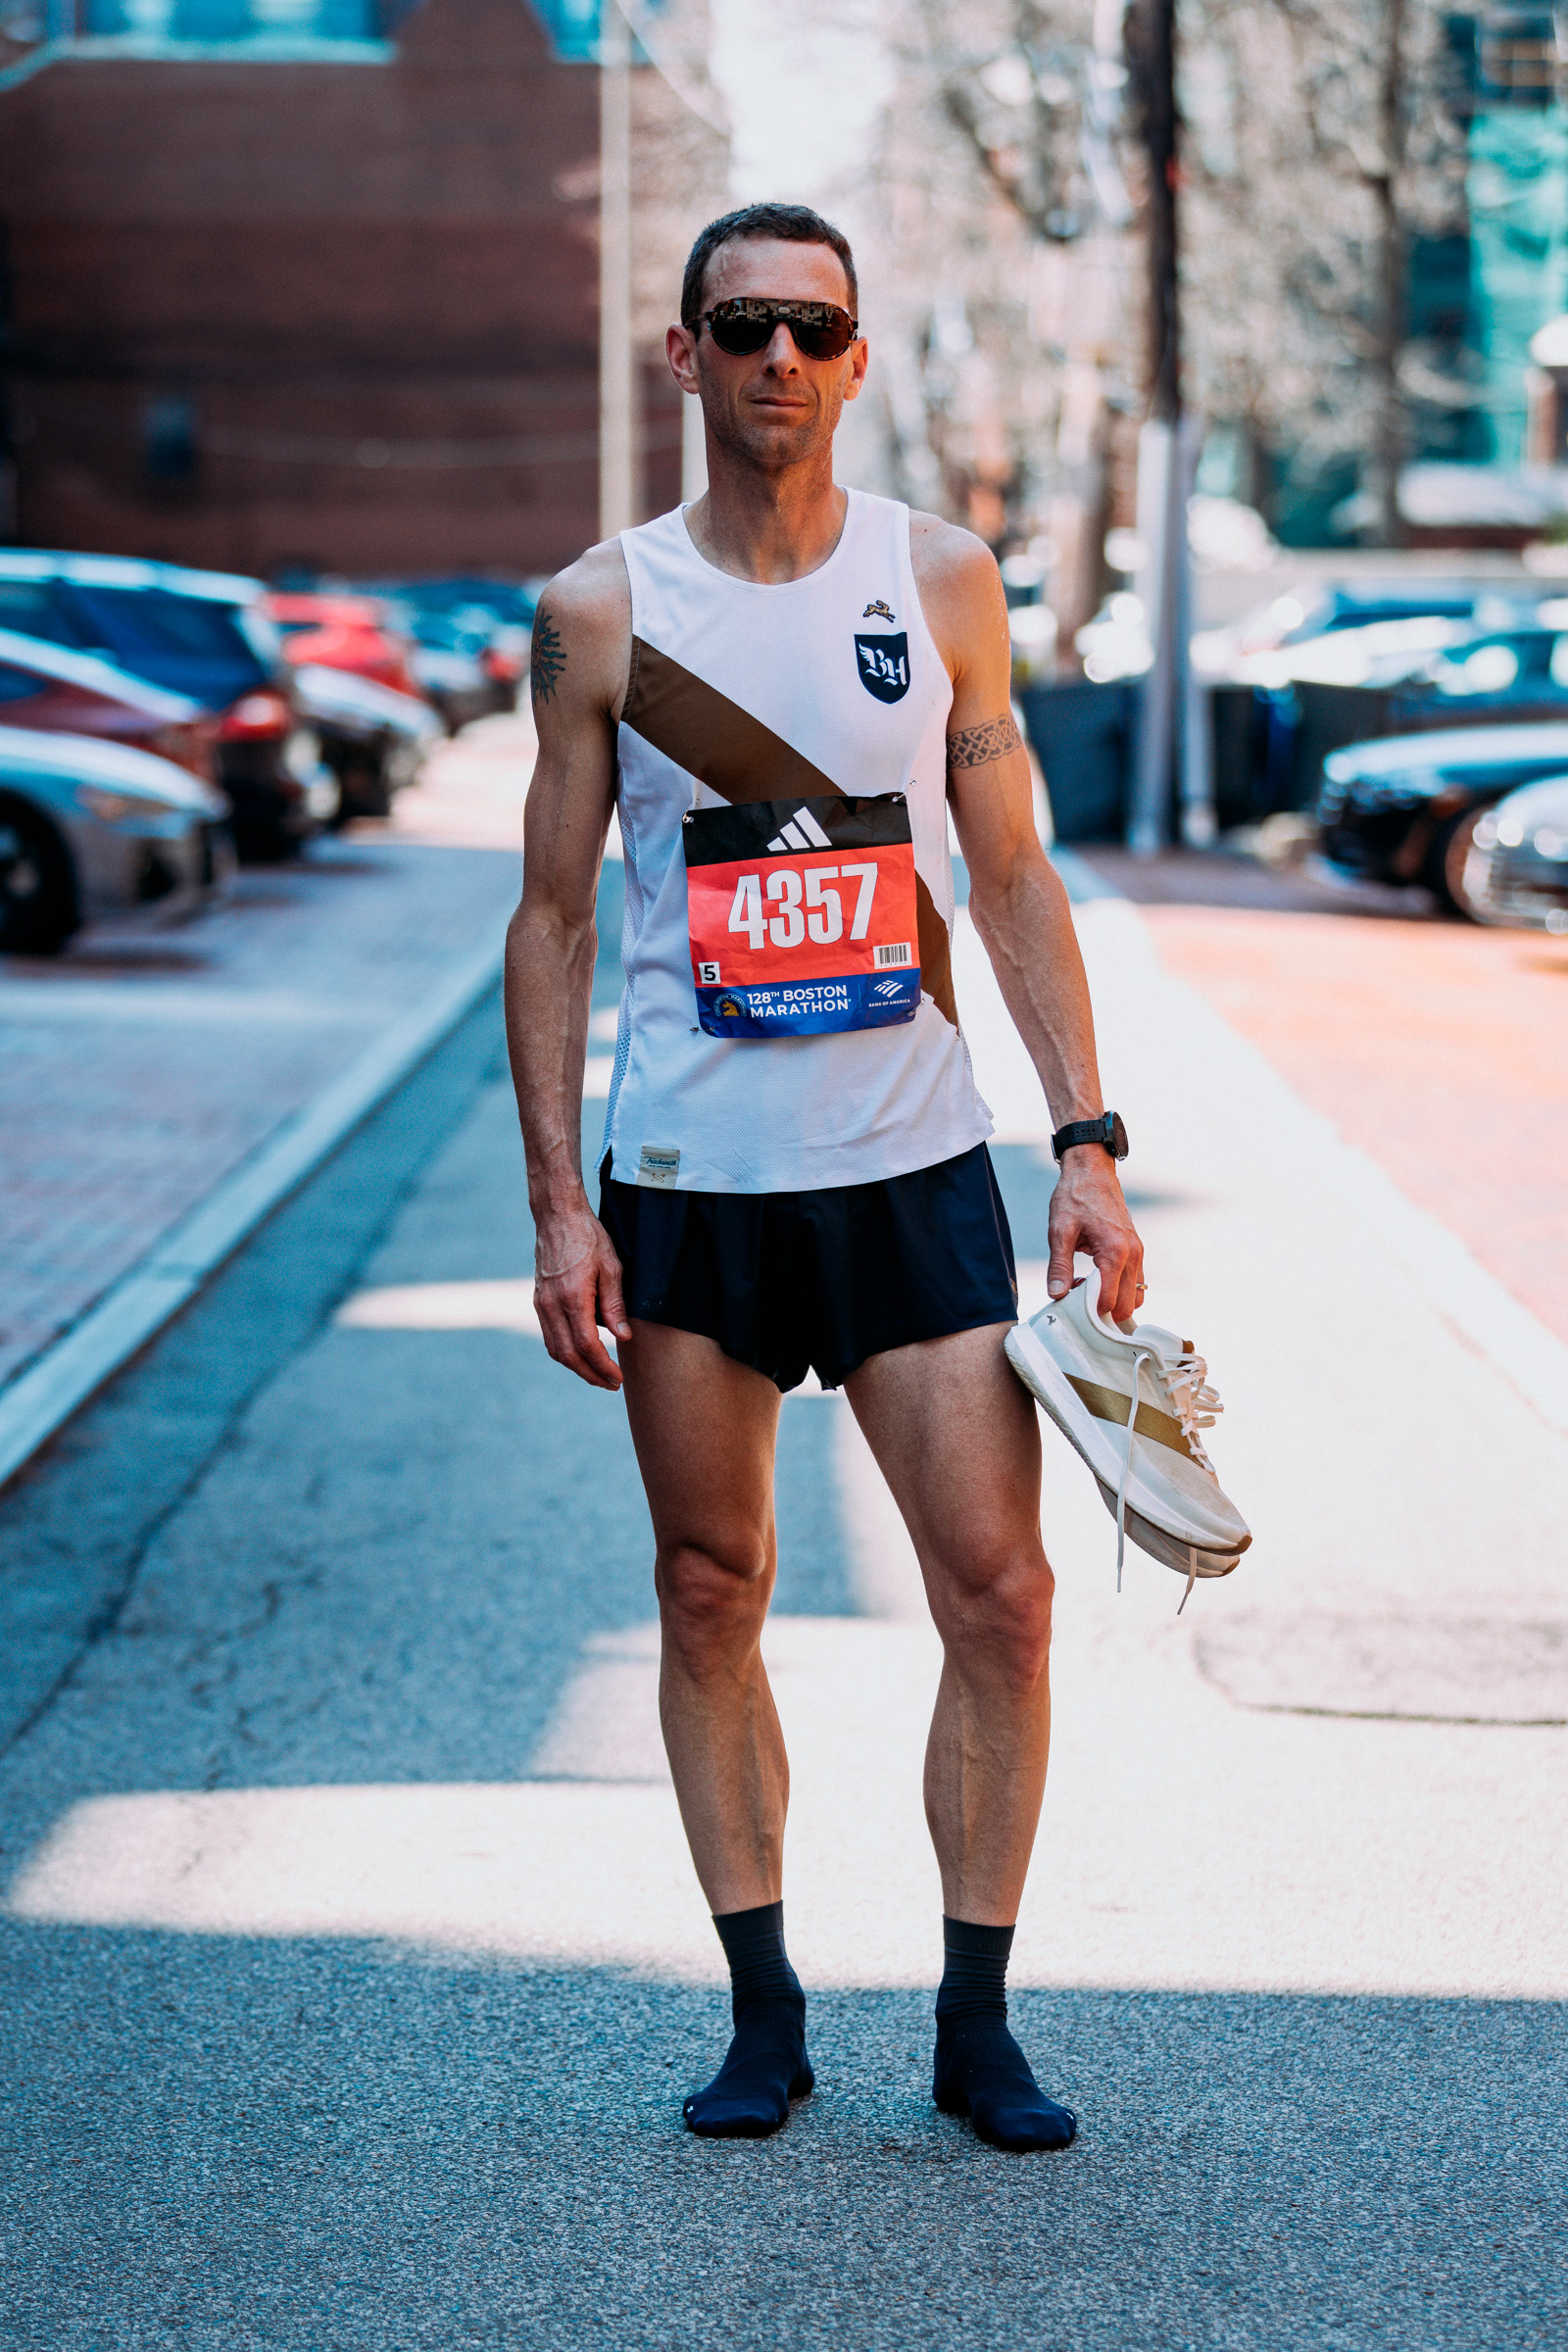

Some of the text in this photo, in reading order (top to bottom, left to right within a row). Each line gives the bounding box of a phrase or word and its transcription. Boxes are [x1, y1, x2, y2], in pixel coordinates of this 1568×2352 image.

[727, 861, 878, 951] 4357
[704, 965, 716, 982] 5
[746, 985, 848, 1005] 128TH BOSTON
[750, 998, 850, 1018] MARATHON
